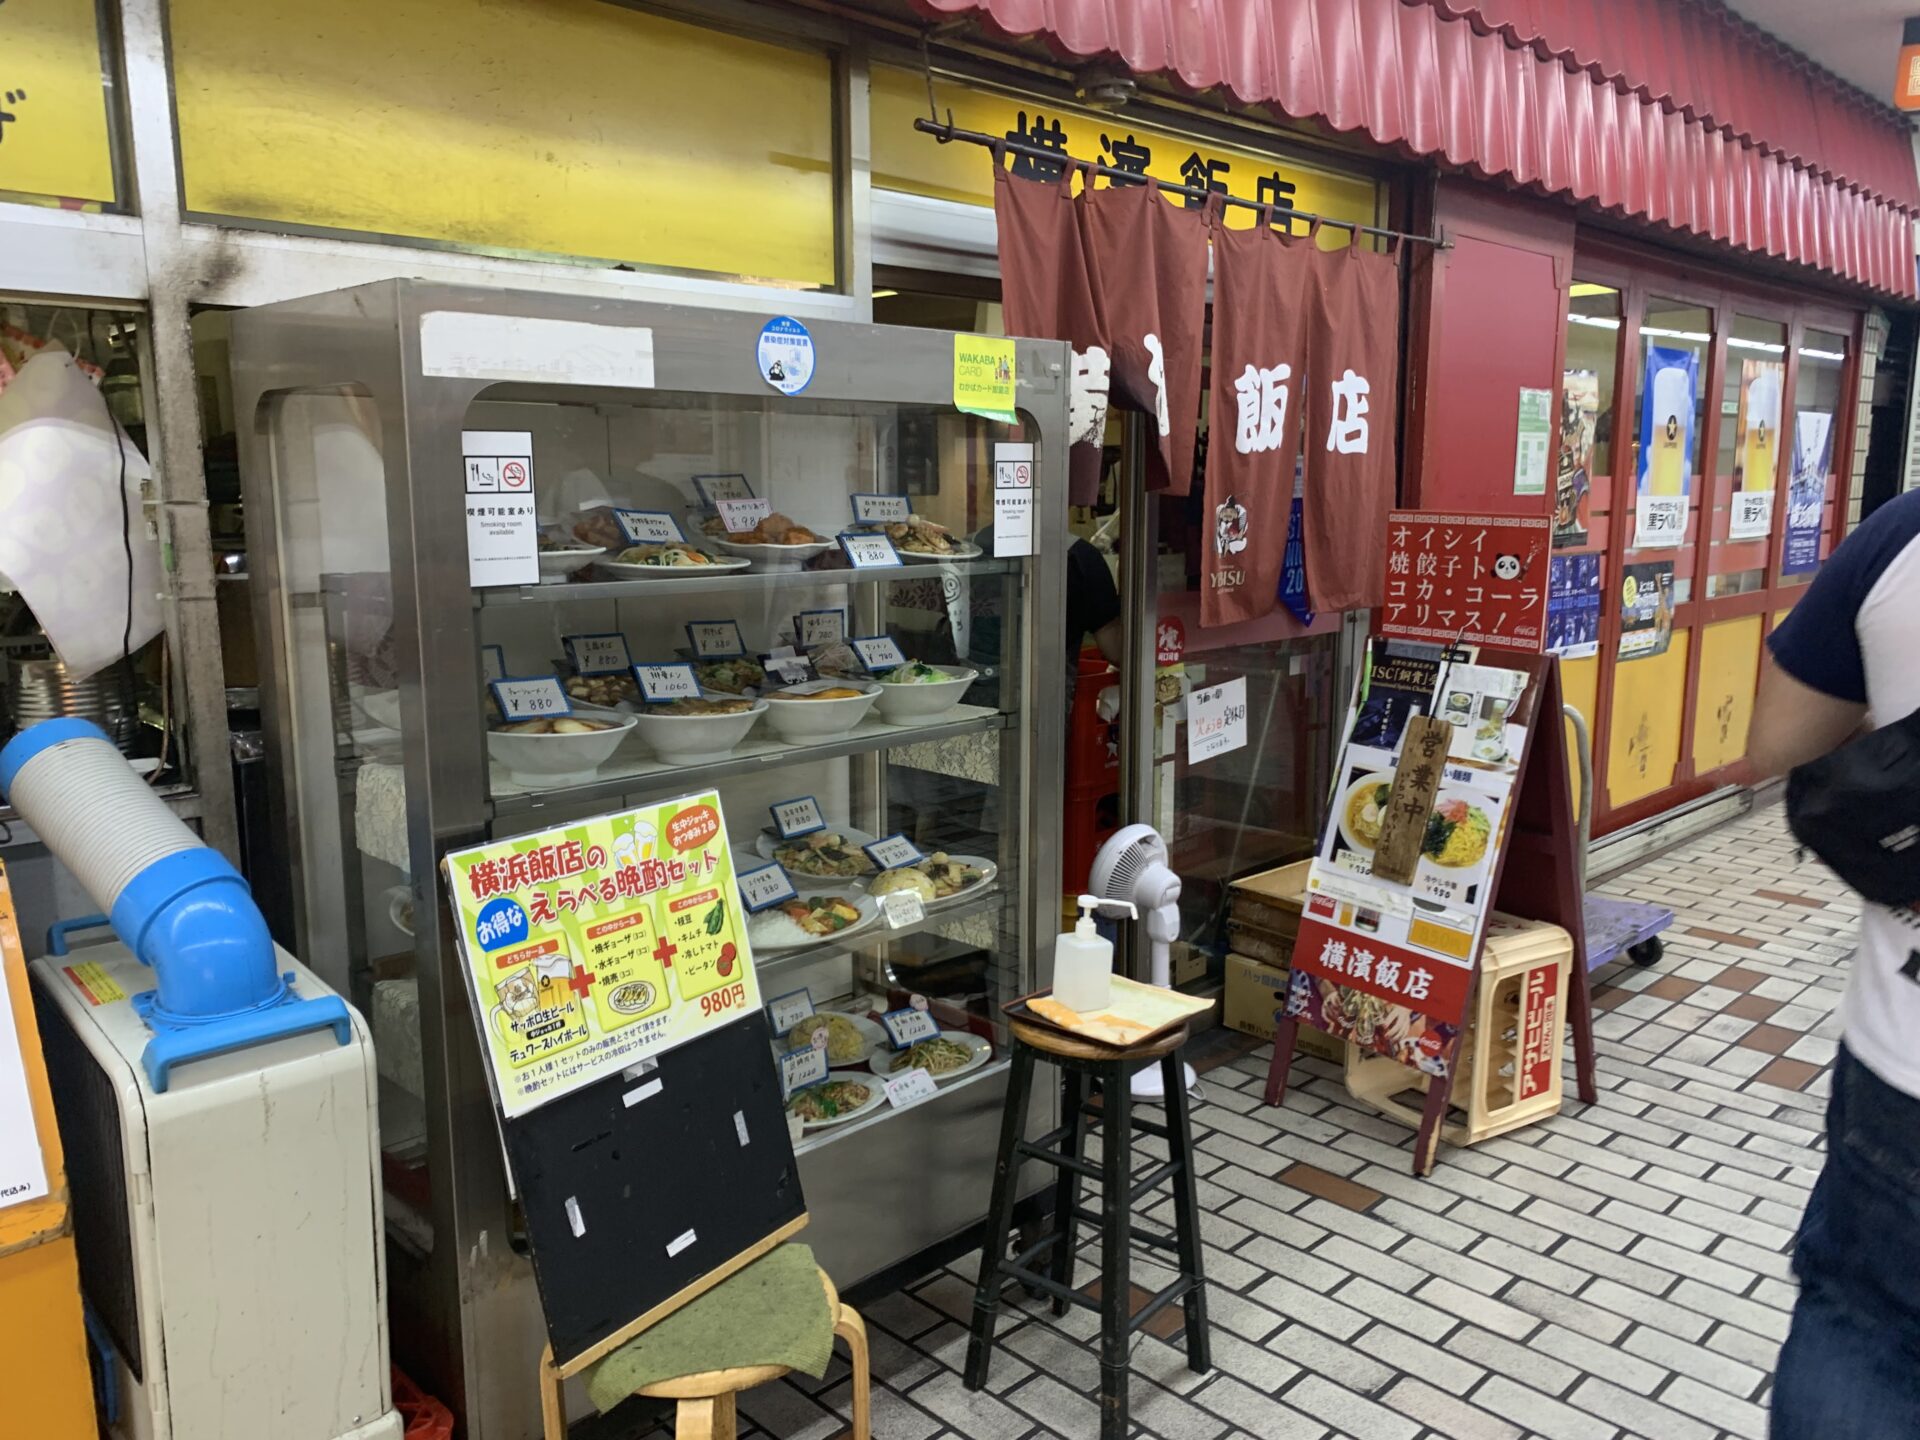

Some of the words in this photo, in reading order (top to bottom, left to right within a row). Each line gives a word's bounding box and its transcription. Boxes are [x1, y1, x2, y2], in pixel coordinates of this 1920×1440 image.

[959, 353, 995, 365] WAKABA
[959, 365, 982, 377] CARD
[467, 507, 534, 517] 喫煙可能室あり
[1392, 525, 1487, 553] オイシイ
[1389, 551, 1485, 580] 焼餃子ト
[1388, 579, 1539, 611] コカ・コーラ
[1403, 731, 1443, 825] 営業中
[468, 839, 607, 900] 横浜飯店の
[529, 849, 719, 925] えらべる晩酌セット
[477, 904, 523, 946] お得な
[1319, 937, 1435, 1000] 横濱飯店
[700, 982, 746, 1018] 980円
[510, 1001, 575, 1034] サッポロ生ビール
[1522, 970, 1546, 1097] アサヒビール
